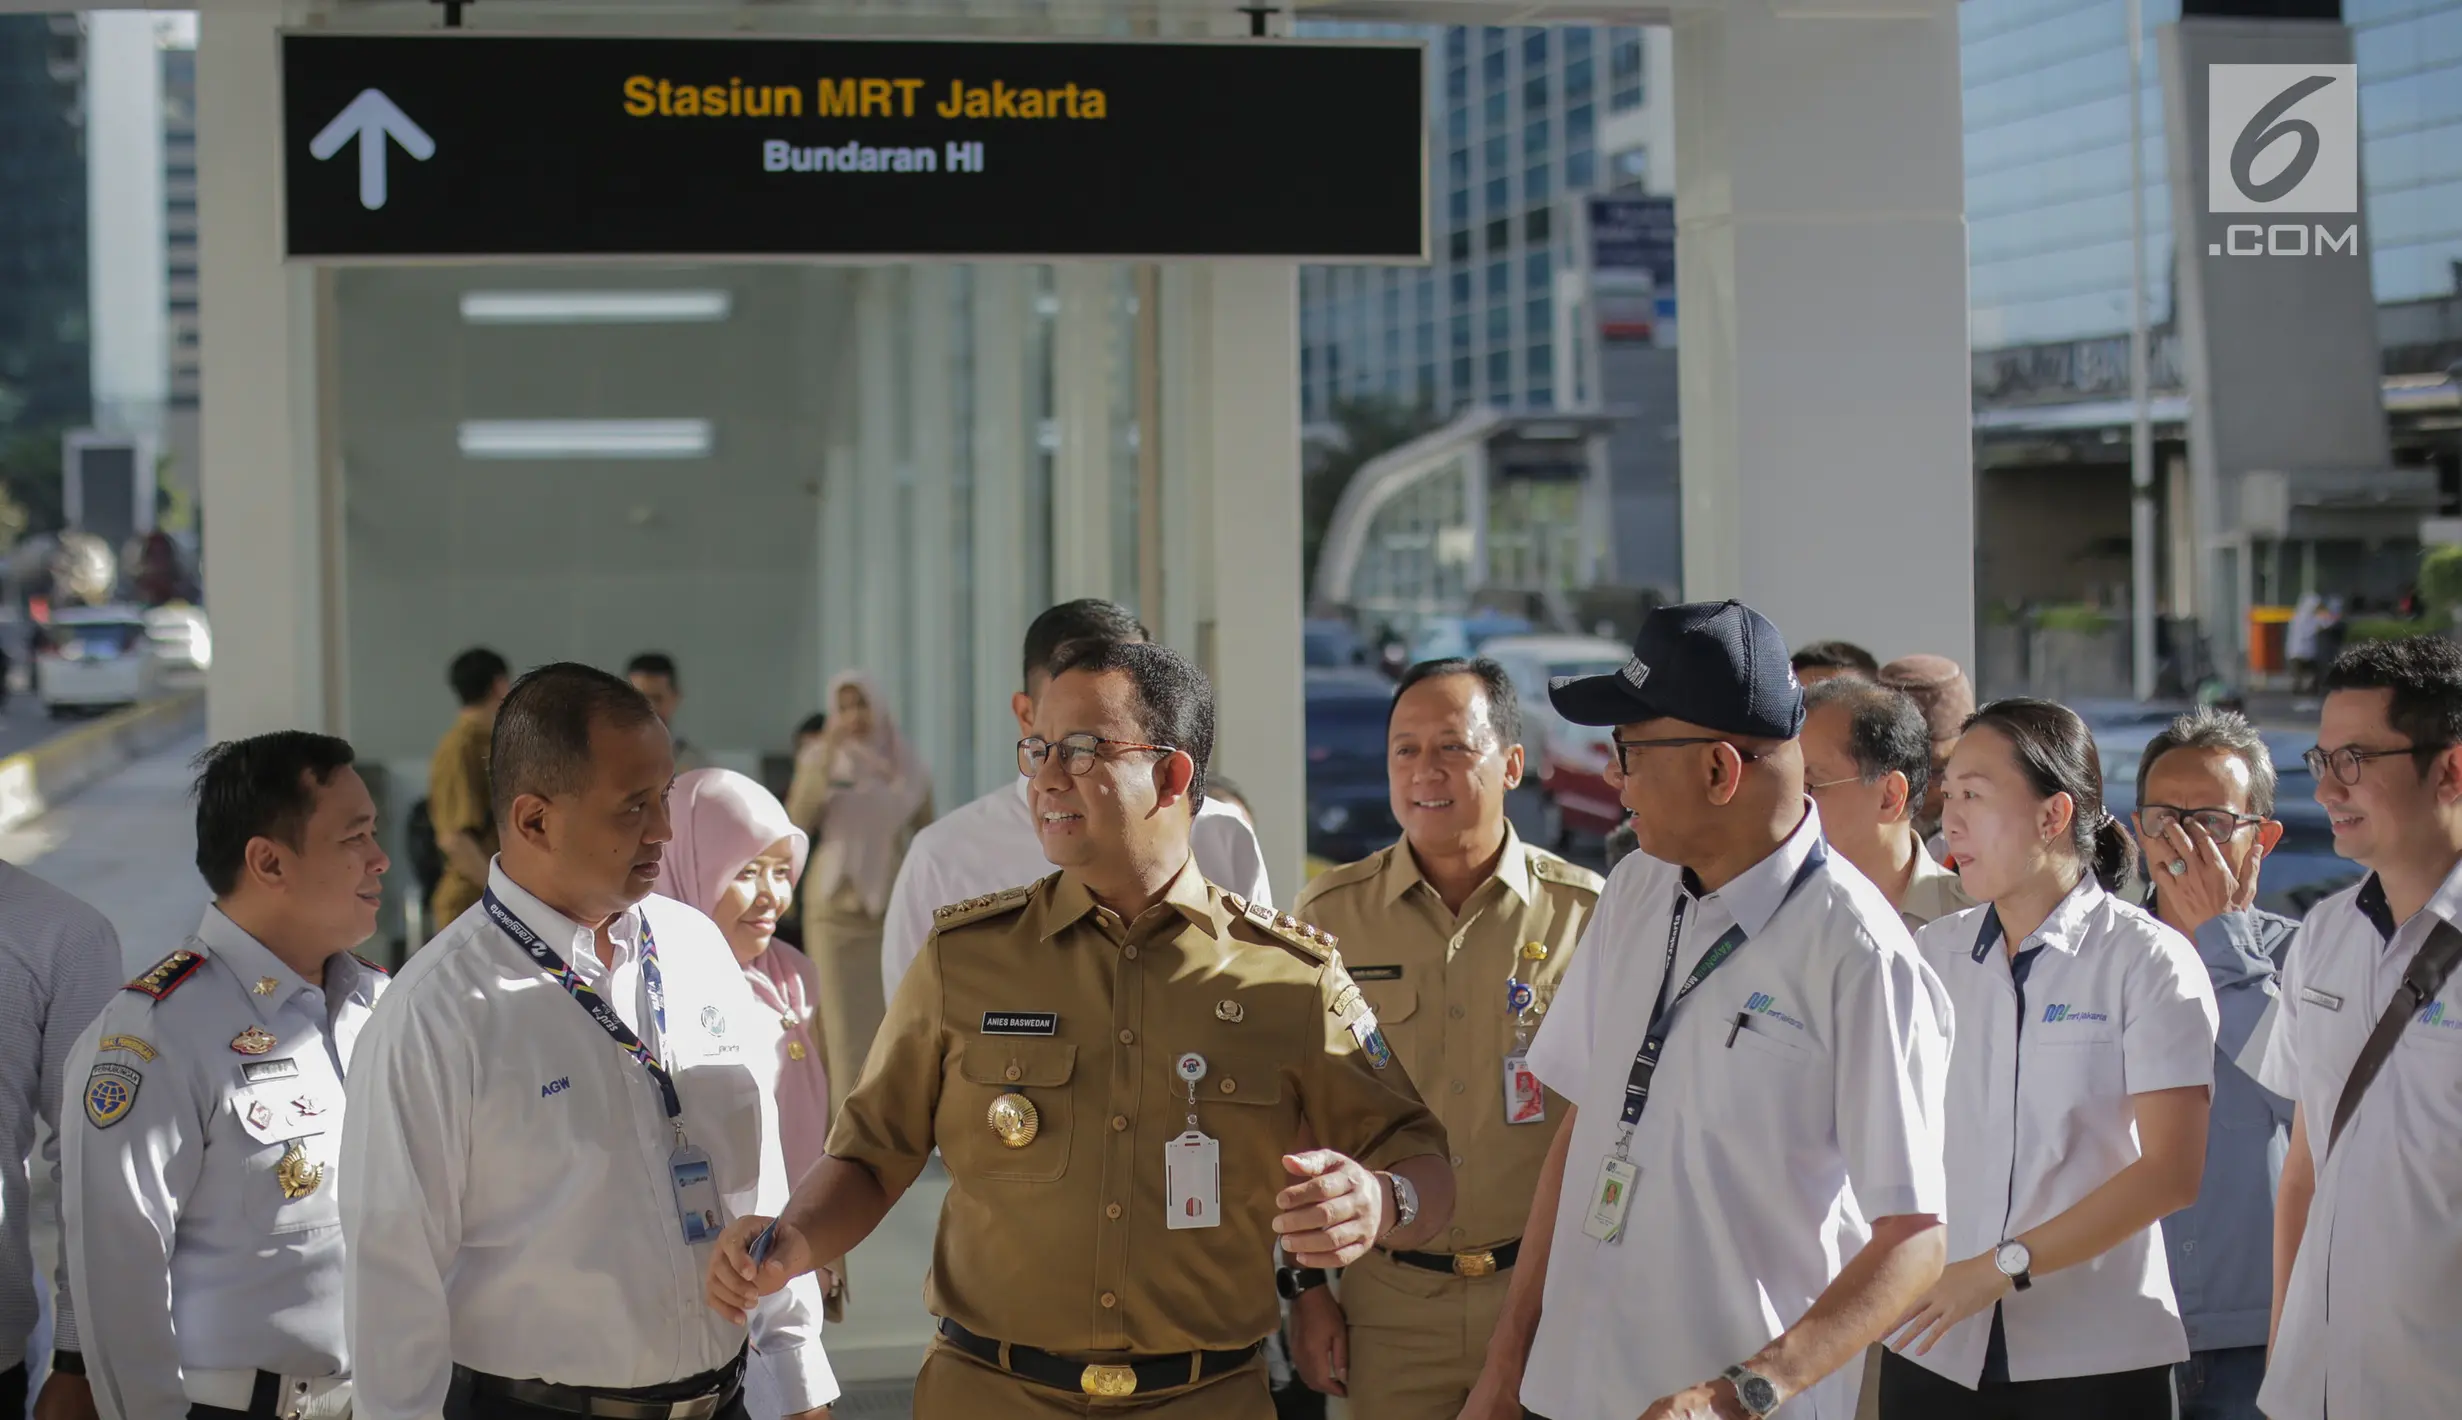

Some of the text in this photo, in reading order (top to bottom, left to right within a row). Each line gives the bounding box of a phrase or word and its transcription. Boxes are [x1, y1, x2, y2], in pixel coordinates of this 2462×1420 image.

[623, 75, 1107, 119] Stasiun MRT Jakarta
[763, 139, 984, 173] Bundaran HI
[489, 903, 536, 945] transjakarta
[986, 1017, 1051, 1028] ANIES BASWEDAN
[541, 1075, 571, 1098] AGW
